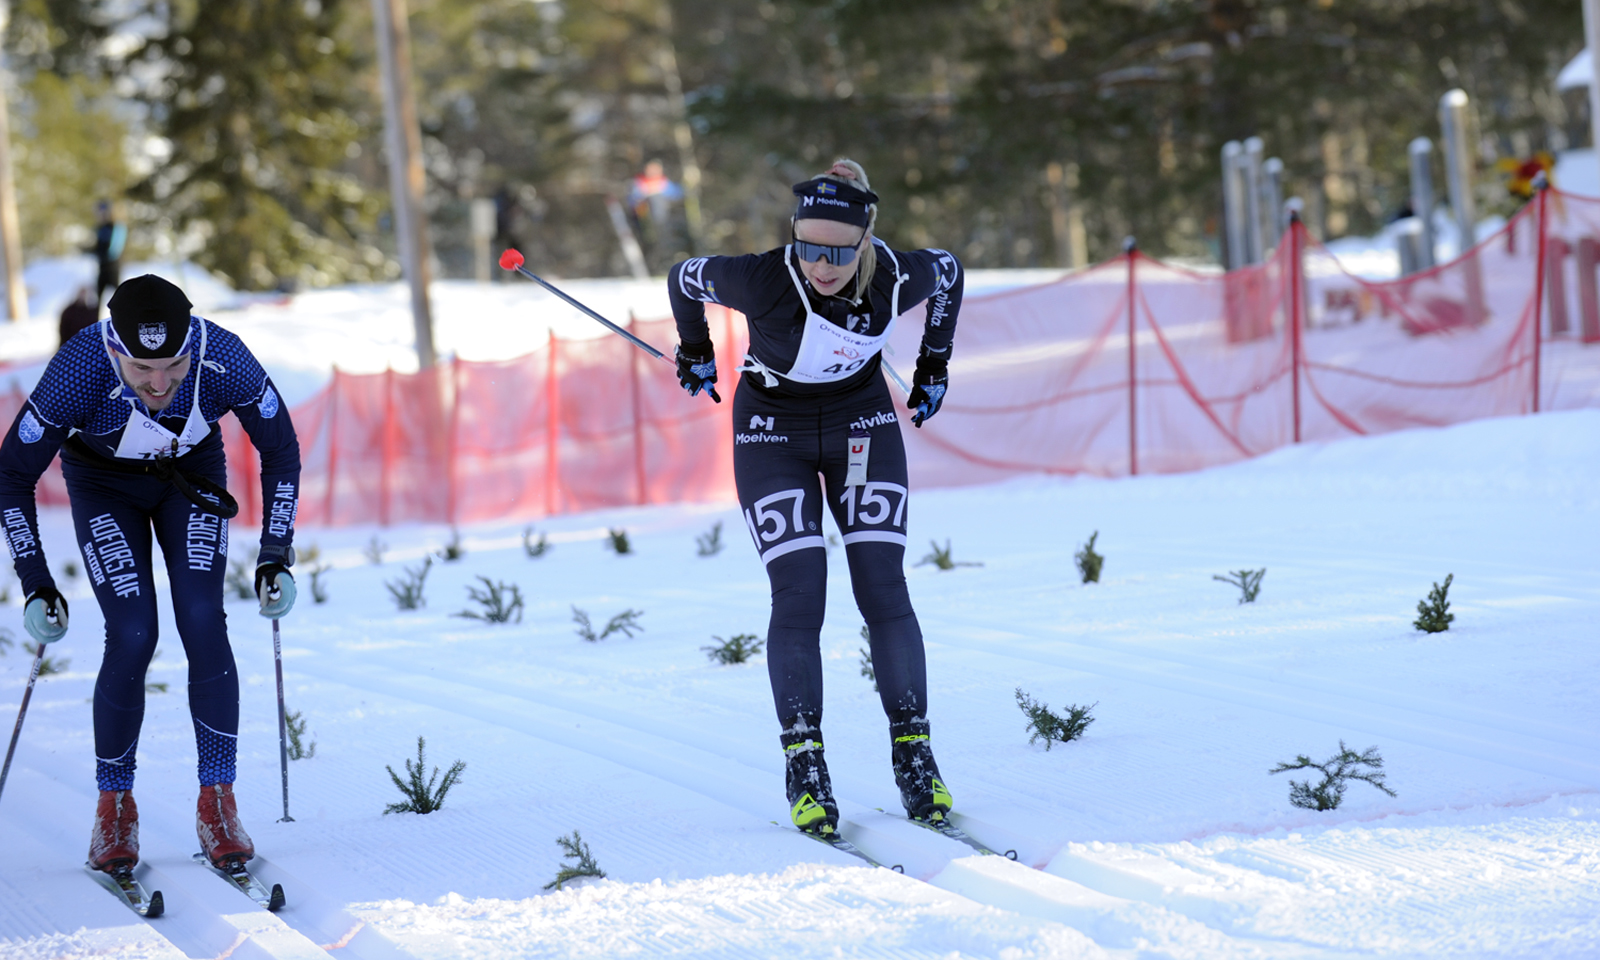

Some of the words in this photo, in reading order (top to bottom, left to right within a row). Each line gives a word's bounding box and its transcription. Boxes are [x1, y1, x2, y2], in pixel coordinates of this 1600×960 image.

[816, 197, 850, 208] Moelven
[735, 431, 788, 446] Moelven
[274, 480, 295, 500] AIF
[839, 481, 908, 527] 157
[3, 507, 37, 552] HOFORS
[88, 512, 136, 575] HOFORS
[186, 512, 220, 572] HOFORS
[83, 541, 107, 587] SKIDOR
[108, 572, 141, 599] AIF
